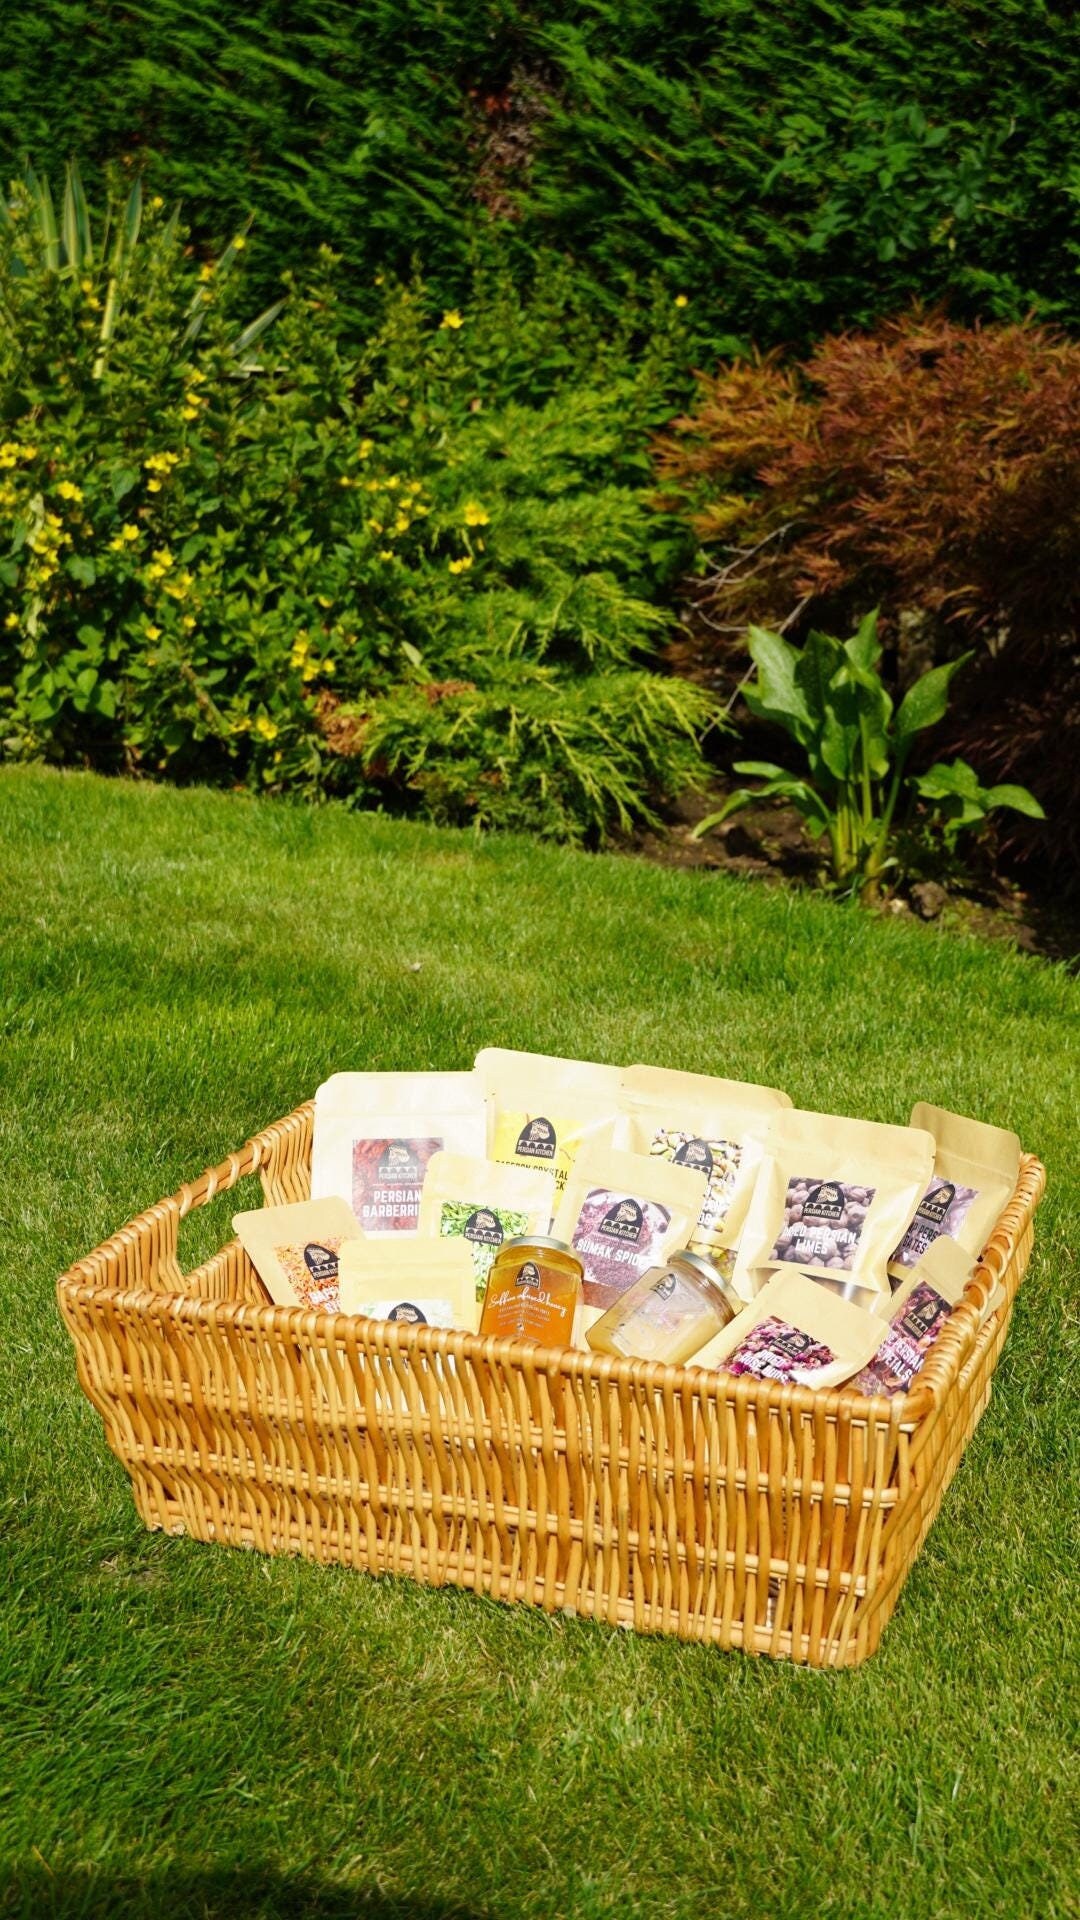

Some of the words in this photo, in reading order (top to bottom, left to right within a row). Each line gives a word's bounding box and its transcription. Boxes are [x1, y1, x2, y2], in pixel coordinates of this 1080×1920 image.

[517, 1145, 535, 1154] PERSIAN
[535, 1148, 553, 1157] KITCHEN
[374, 1189, 422, 1203] PERSIAN
[362, 1204, 419, 1218] BARBERRI
[803, 1207, 821, 1215] PERSIAN
[820, 1209, 840, 1218] KITCHEN
[600, 1225, 619, 1235] PERSIAN
[619, 1229, 639, 1239] KITCHEN
[809, 1226, 857, 1244] PERSIAN
[576, 1238, 614, 1260] SUMAK
[795, 1238, 829, 1255] LIMES
